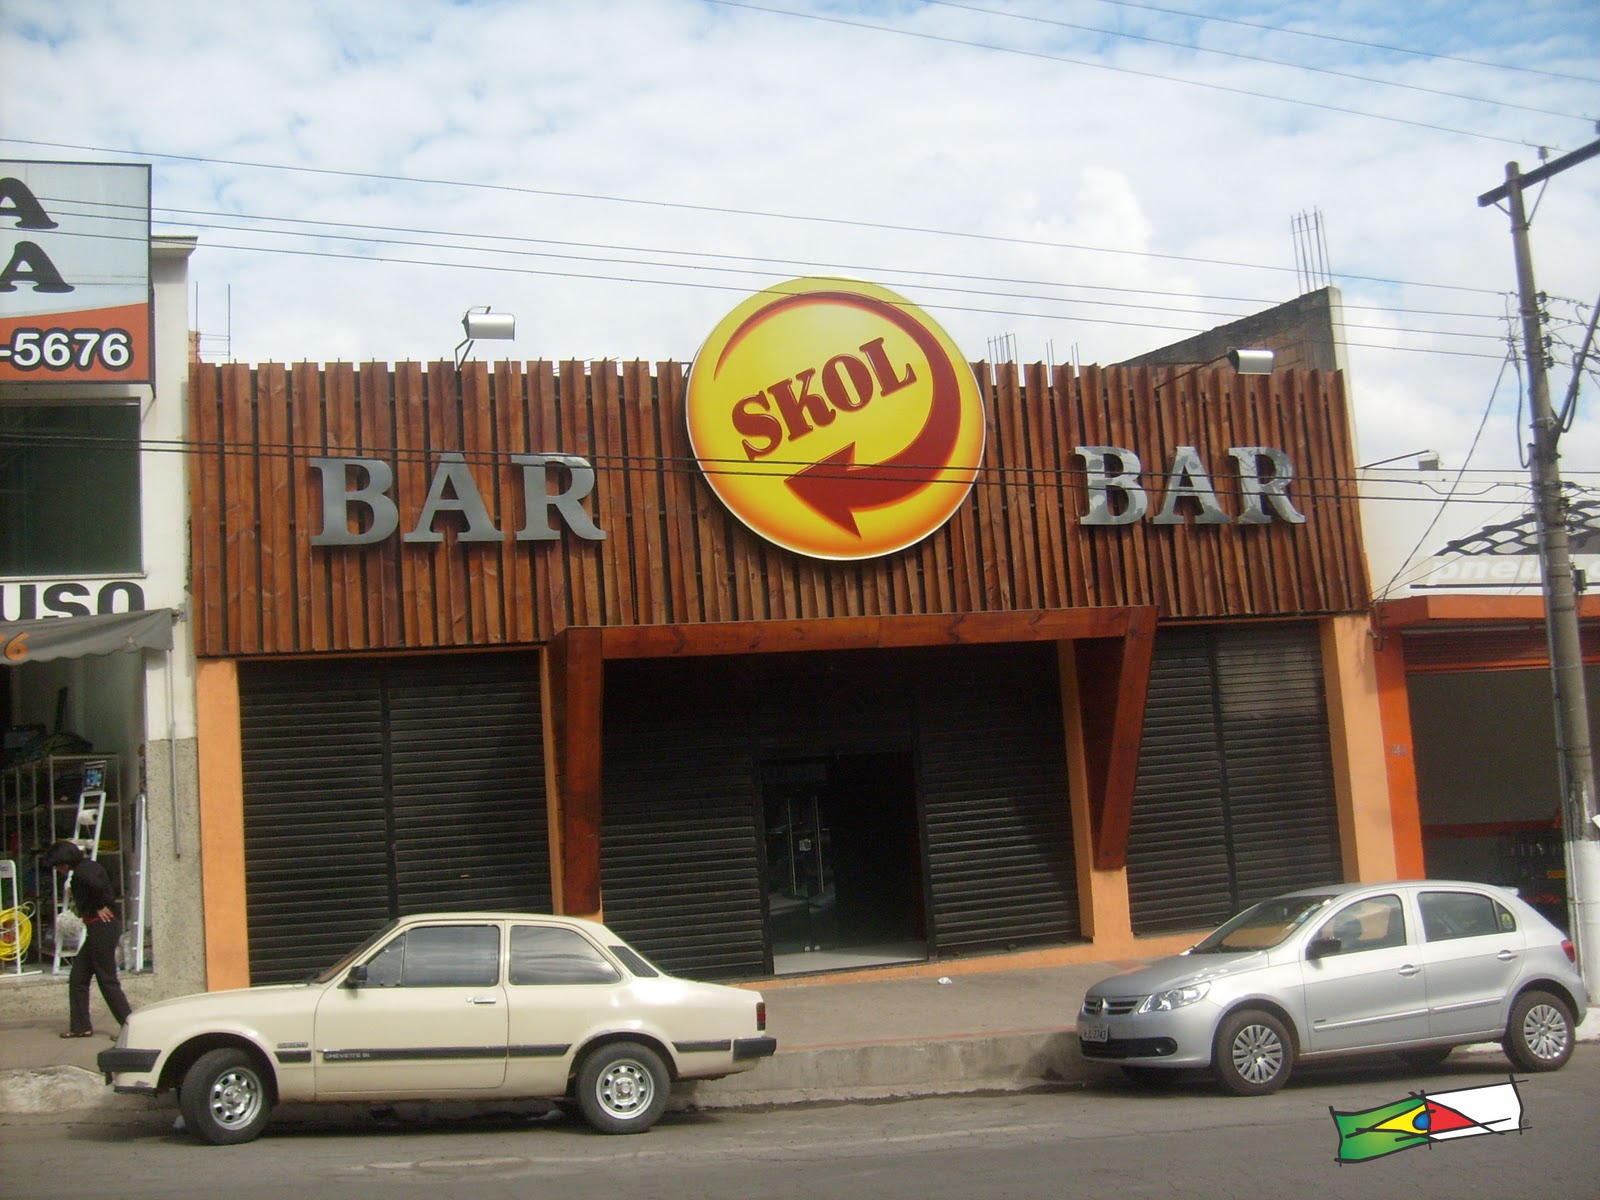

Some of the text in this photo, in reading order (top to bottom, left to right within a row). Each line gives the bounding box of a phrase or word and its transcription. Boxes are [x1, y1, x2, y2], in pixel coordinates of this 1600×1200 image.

[731, 336, 917, 461] SKOL
[310, 453, 606, 545] BAR
[1075, 446, 1306, 525] BAR
